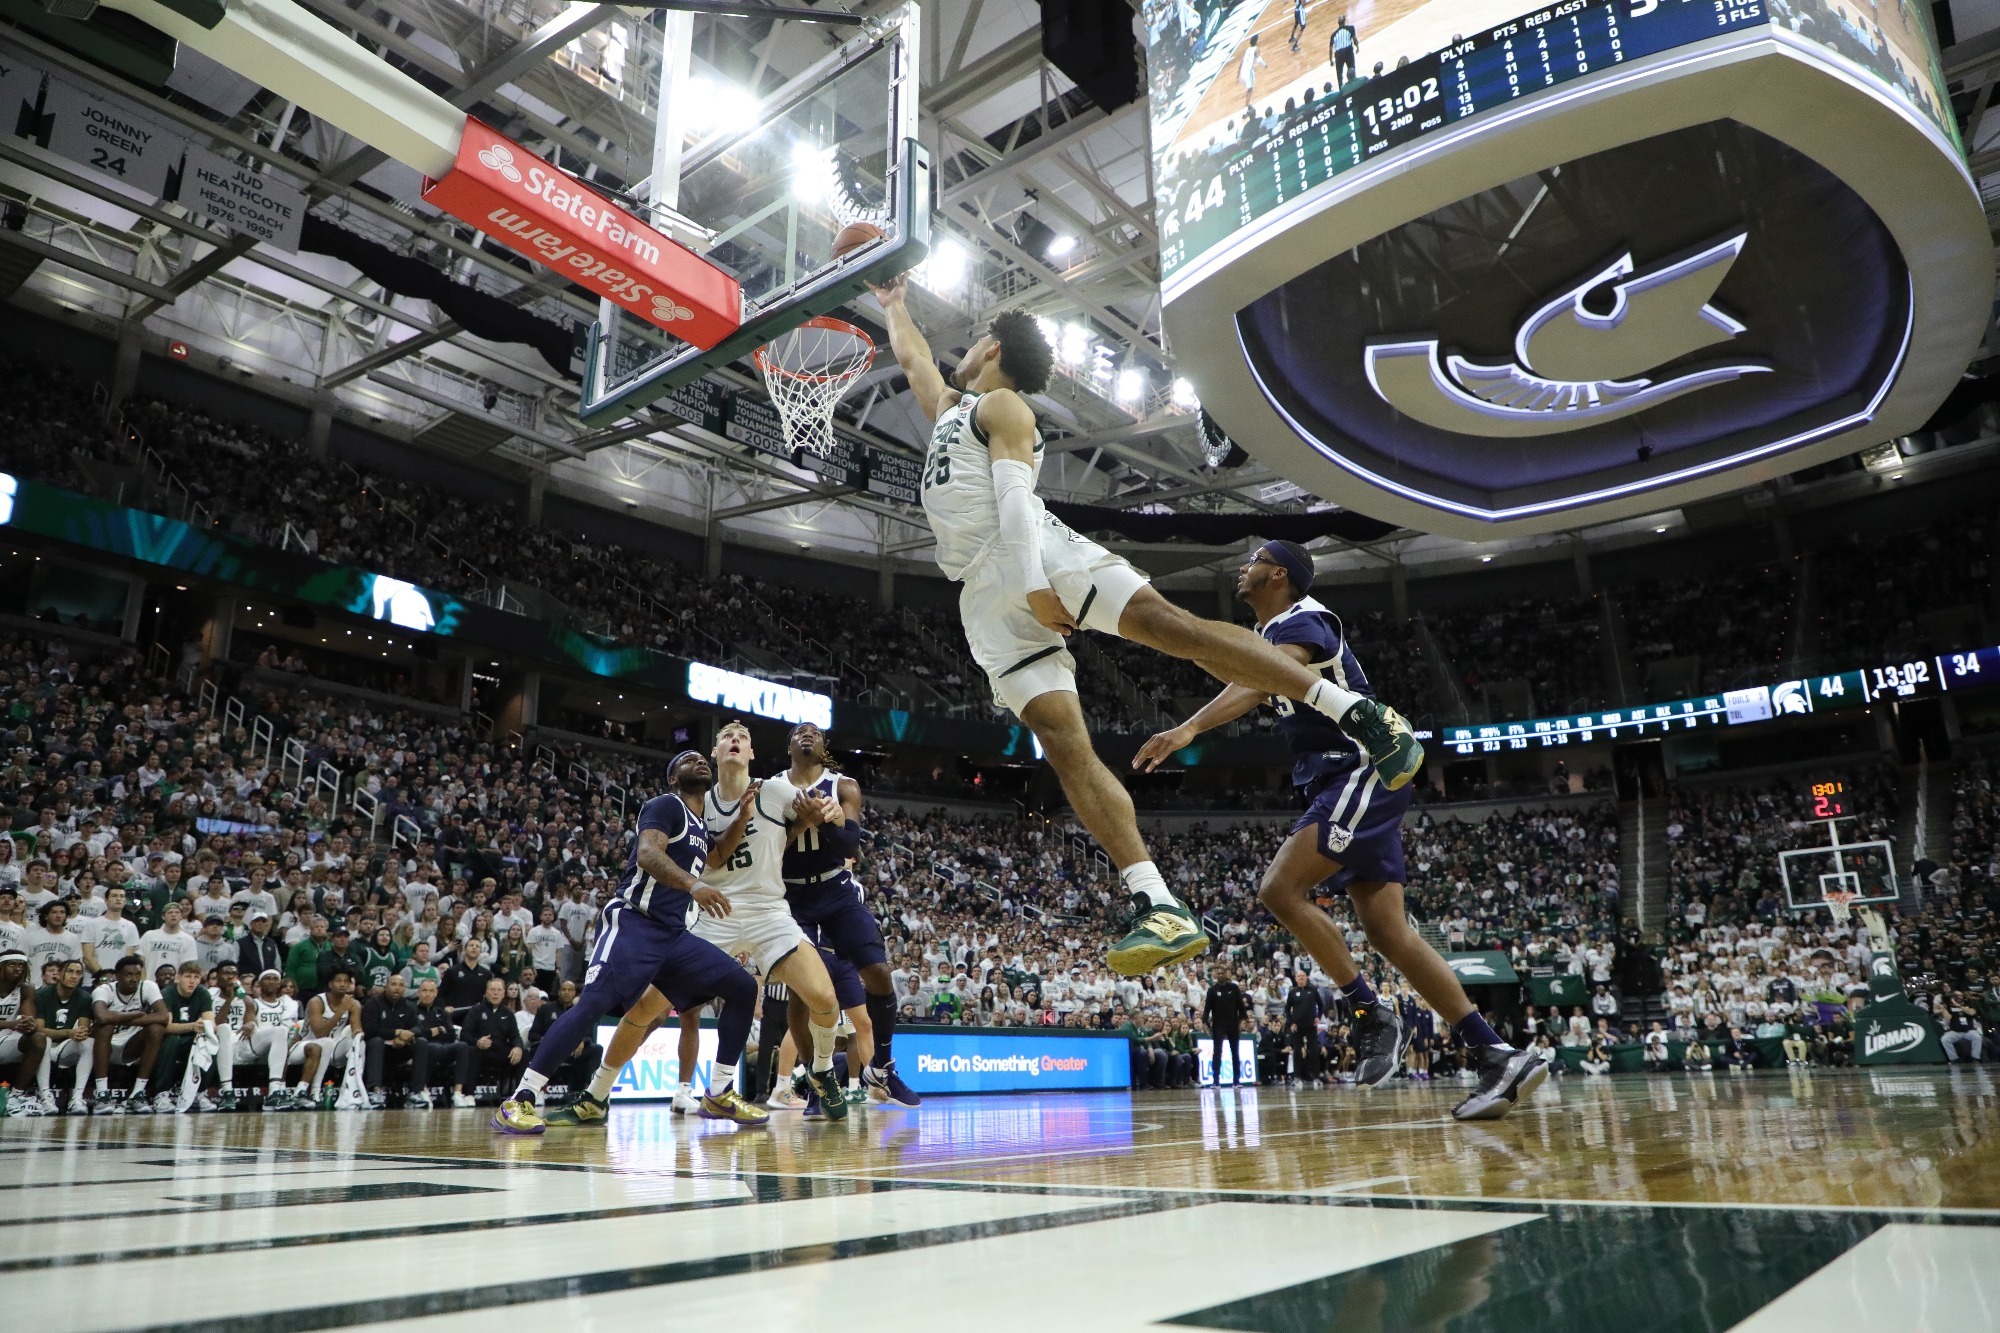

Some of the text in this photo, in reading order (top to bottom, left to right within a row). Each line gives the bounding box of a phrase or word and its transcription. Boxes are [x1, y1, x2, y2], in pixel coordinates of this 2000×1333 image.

[1714, 1, 1724, 12] 3
[1717, 5, 1760, 25] 3 FLS
[1440, 0, 1588, 64] PLYR PTS REB ASST
[1456, 4, 1612, 69] 4 4 2 1 1
[1457, 27, 1618, 93] 11 11 3 1 0
[1458, 16, 1615, 81] 5 8 4 1 3
[1458, 39, 1620, 105] 13 0 1 0 0
[1460, 51, 1622, 117] 23 2 5 0 3
[1363, 78, 1440, 126] 13:02
[82, 106, 152, 144] JOHNNY
[1230, 96, 1352, 176] PLYR PTS REB ASST F
[1390, 114, 1414, 131] 2ND
[1421, 116, 1441, 130] POSS
[86, 124, 143, 156] GREEN
[1240, 110, 1353, 181] 1 3 0 0 1
[1369, 140, 1388, 154] POSS
[90, 148, 126, 176] 24
[1240, 121, 1355, 192] 3 6 0 1 1
[1241, 132, 1356, 202] 5 2 0 0 1
[232, 170, 263, 190] JUD
[1240, 143, 1358, 214] 15 1 7 0 0
[1241, 154, 1360, 226] 25 6 9 2 2
[198, 168, 292, 218] HEATHCOTE
[1184, 174, 1226, 224] 44
[201, 188, 283, 231] HEAD COACH
[207, 203, 235, 222] 1976
[246, 220, 272, 239] 1995
[1162, 239, 1184, 260] TOL 3
[1163, 251, 1185, 272] FLS 3
[670, 390, 720, 417] AMPIONS
[690, 390, 708, 402] TEN
[736, 397, 774, 418] WOMEN'S
[672, 403, 702, 424] 2005
[745, 432, 778, 452] 2005
[822, 464, 843, 480] 2011
[877, 452, 922, 473] WOMEN'S
[882, 464, 918, 480] BIG TEN
[888, 486, 912, 500] 2014
[1820, 653, 1980, 697] 44 13:02 34
[689, 661, 832, 730] SPARTANS
[1728, 694, 1750, 704] FOULS
[1897, 683, 1915, 696] 2ND
[1509, 725, 1525, 734] FT%
[1632, 710, 1645, 720] AST
[1705, 699, 1720, 709] STL
[1730, 710, 1744, 720] TOL
[1483, 741, 1500, 751] 27.3
[1510, 738, 1527, 748] 73.3
[1812, 782, 1842, 796] 13:01
[797, 826, 820, 853] 11
[1865, 1026, 1920, 1057] LIBMAN
[918, 1054, 1088, 1076] Plan On Something Greater
